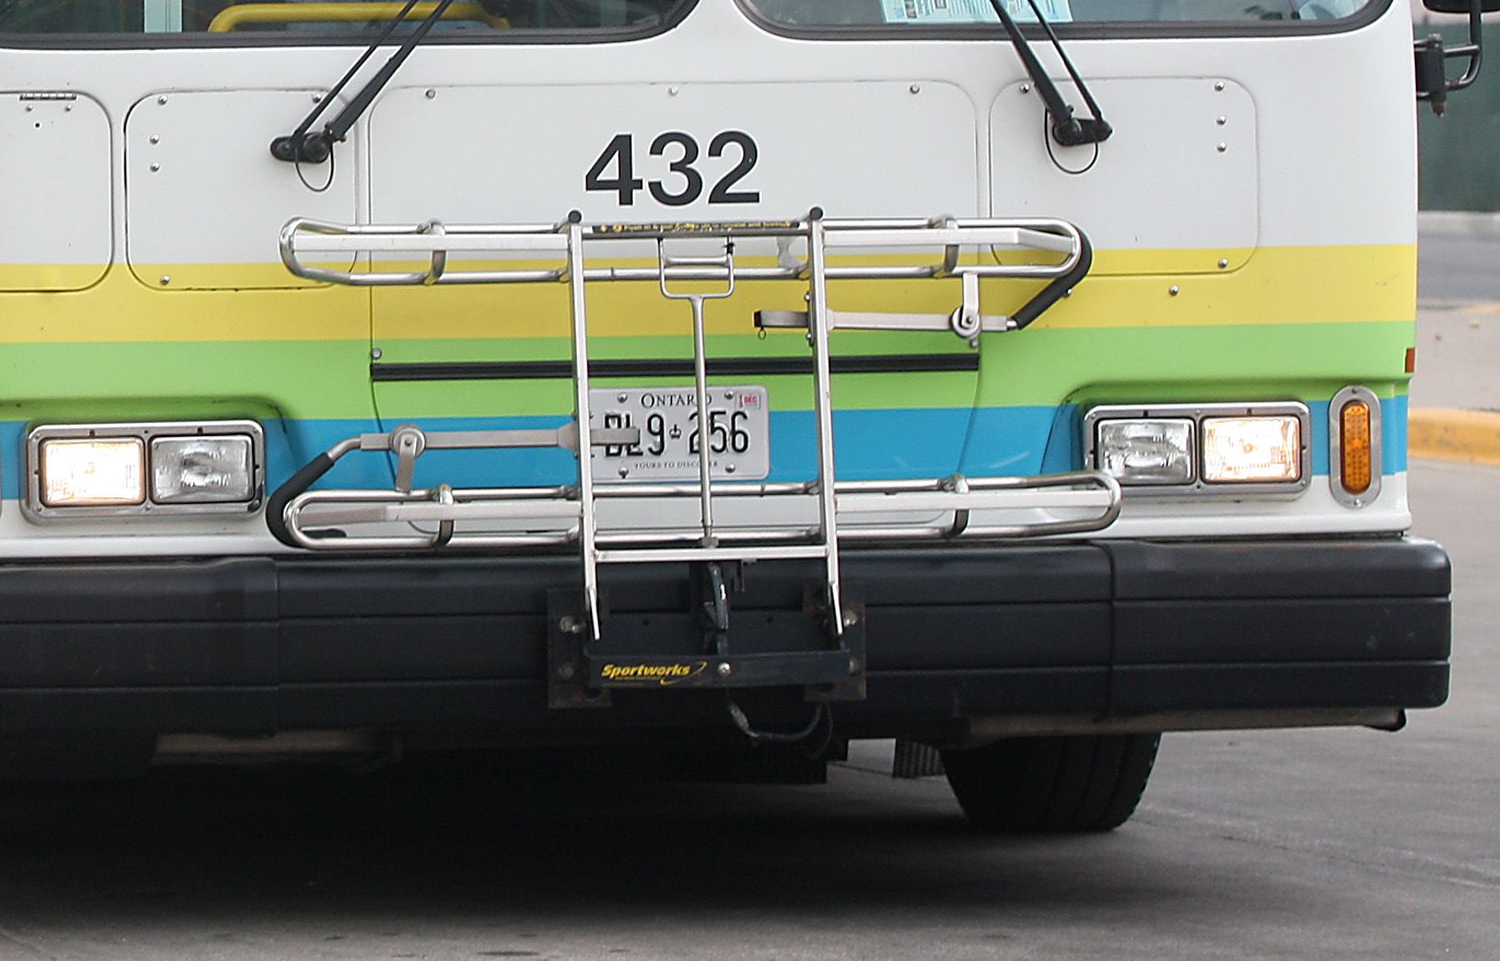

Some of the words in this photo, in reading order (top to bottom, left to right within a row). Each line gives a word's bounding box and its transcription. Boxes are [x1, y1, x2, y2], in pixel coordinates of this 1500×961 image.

[585, 131, 760, 206] 432
[641, 393, 712, 408] ONTARO
[601, 664, 691, 678] Sportworks
